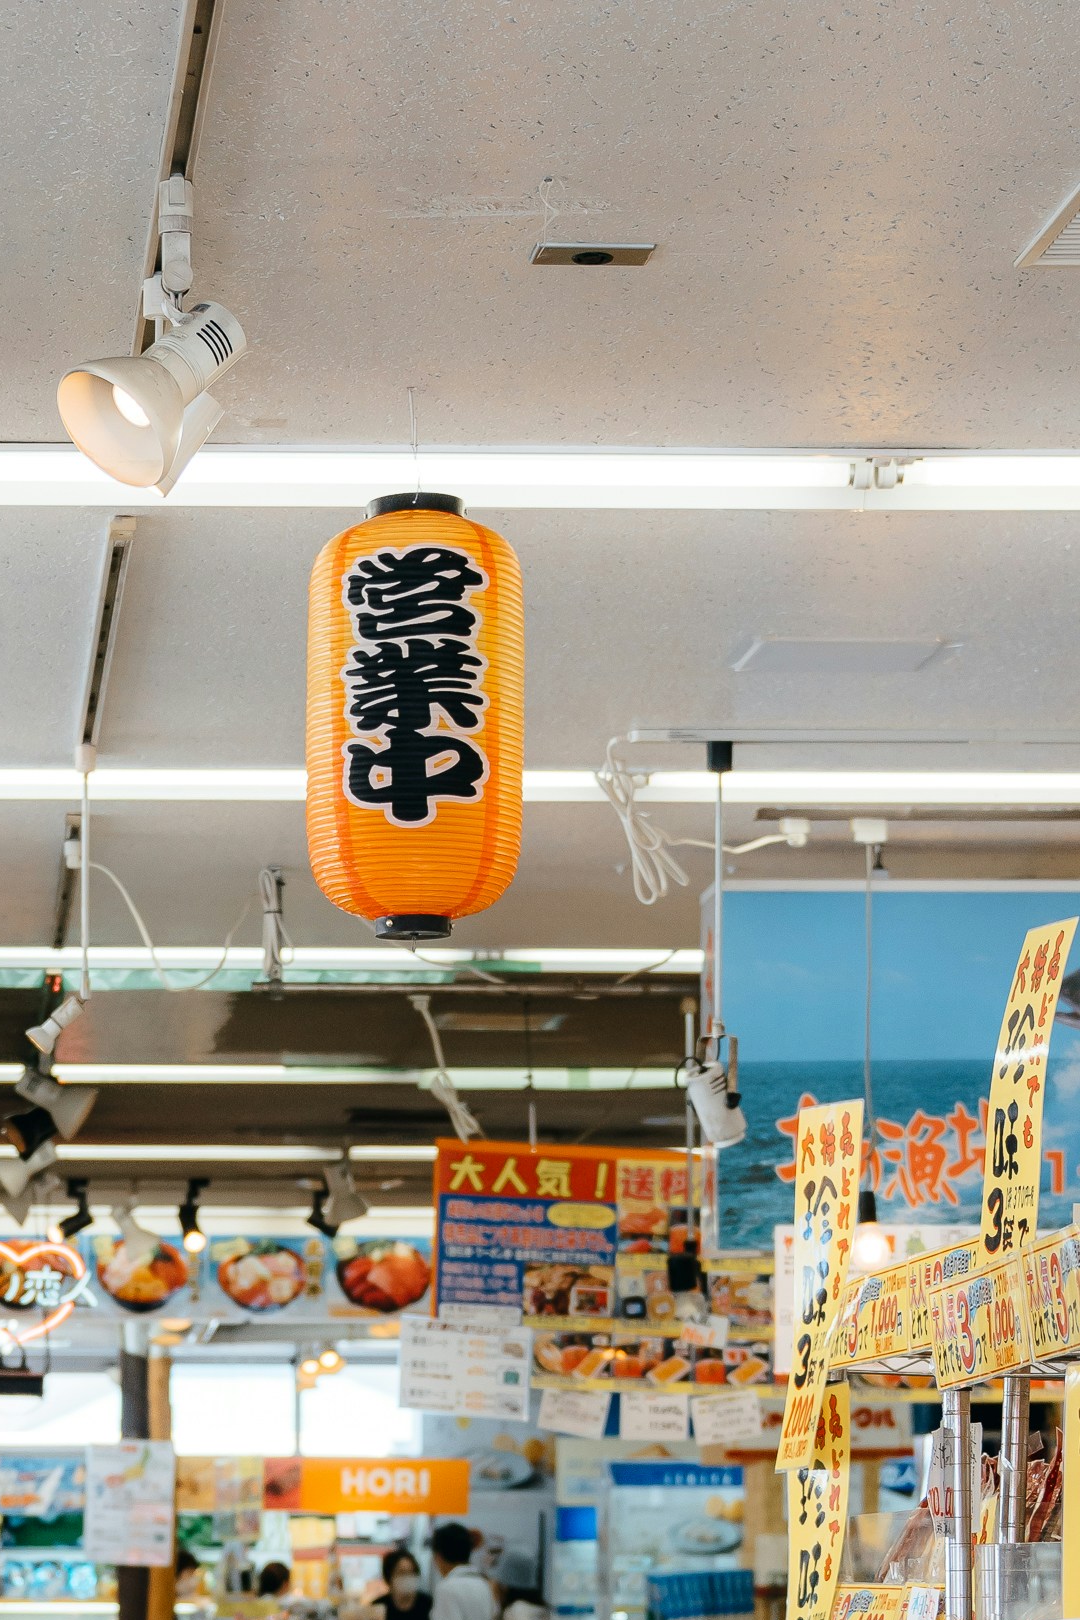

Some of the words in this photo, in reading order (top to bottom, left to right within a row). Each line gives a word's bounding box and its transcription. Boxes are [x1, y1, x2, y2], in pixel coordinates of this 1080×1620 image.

[343, 545, 487, 825] 営業中
[992, 1003, 1035, 1180] 珍味
[449, 1155, 608, 1199] 大人気！
[340, 1467, 431, 1498] HORI
